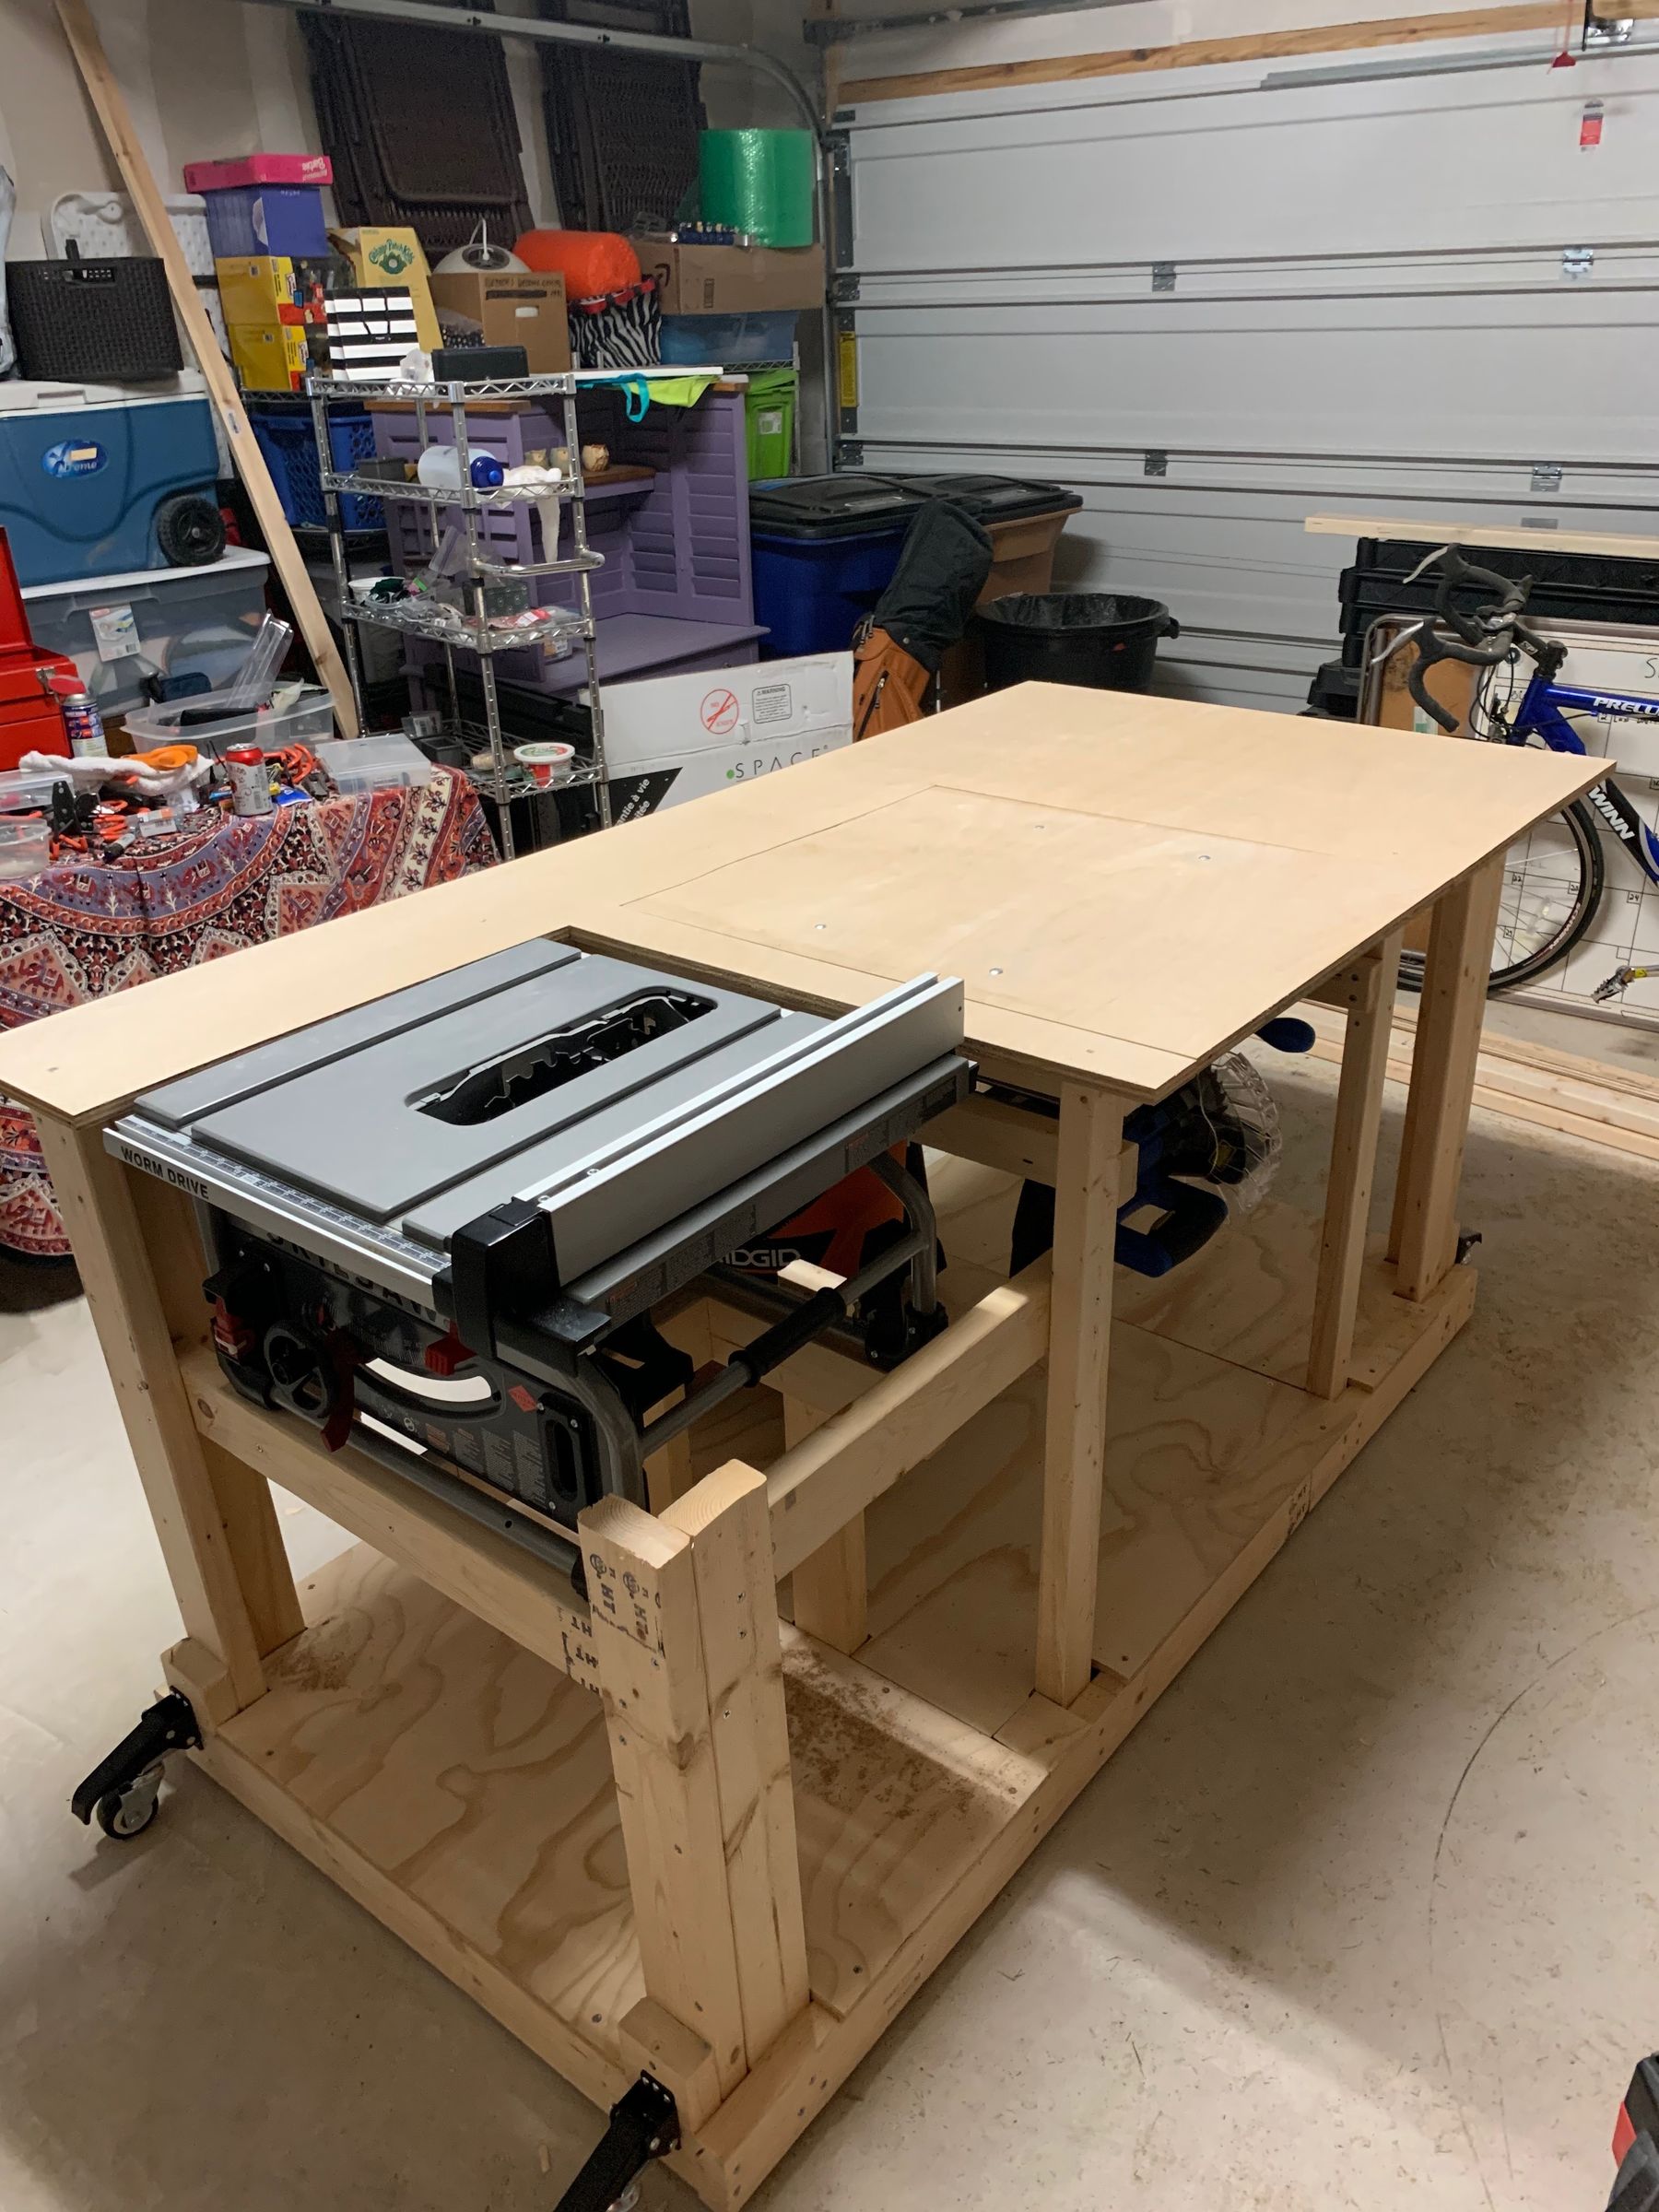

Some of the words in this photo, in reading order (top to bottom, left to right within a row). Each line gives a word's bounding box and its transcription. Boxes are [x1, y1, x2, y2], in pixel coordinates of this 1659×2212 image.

[636, 778, 651, 794] vie
[633, 800, 651, 820] itée
[121, 1146, 163, 1179] WORM
[167, 1169, 209, 1199] DRIVE
[719, 1248, 801, 1267] IDGID
